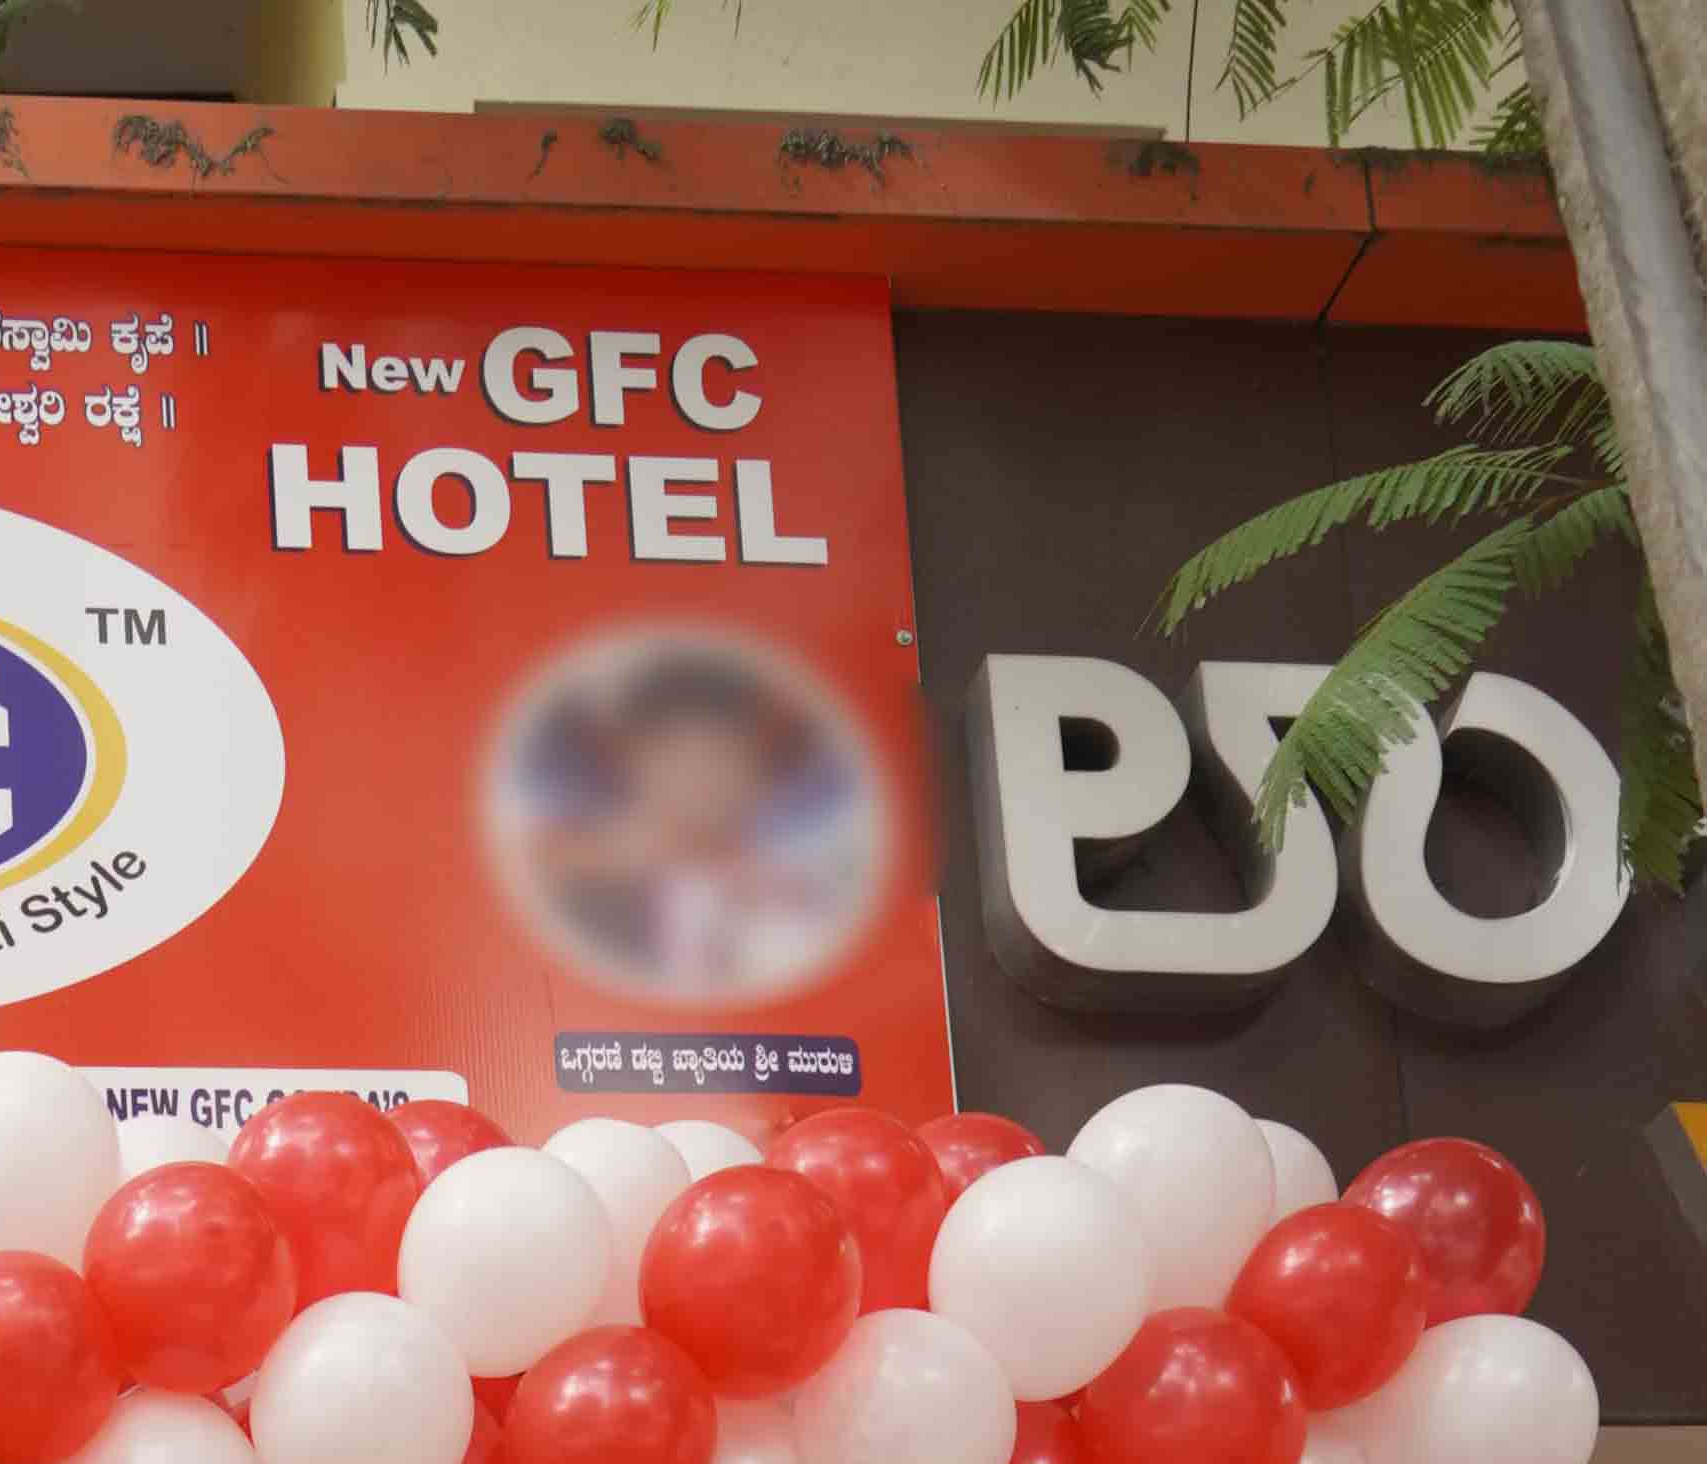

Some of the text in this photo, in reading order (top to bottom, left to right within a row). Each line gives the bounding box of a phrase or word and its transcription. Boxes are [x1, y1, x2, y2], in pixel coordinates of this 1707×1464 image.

[111, 314, 174, 374] ಕೃಪೆ
[321, 326, 762, 430] New GFC
[85, 385, 141, 447] ರಕ್ಷೆ
[271, 443, 828, 566] HOTEL
[85, 608, 168, 646] TM
[20, 849, 147, 934] Style
[755, 1043, 779, 1081] ಶ್ರೀ
[190, 1087, 254, 1129] GFC
